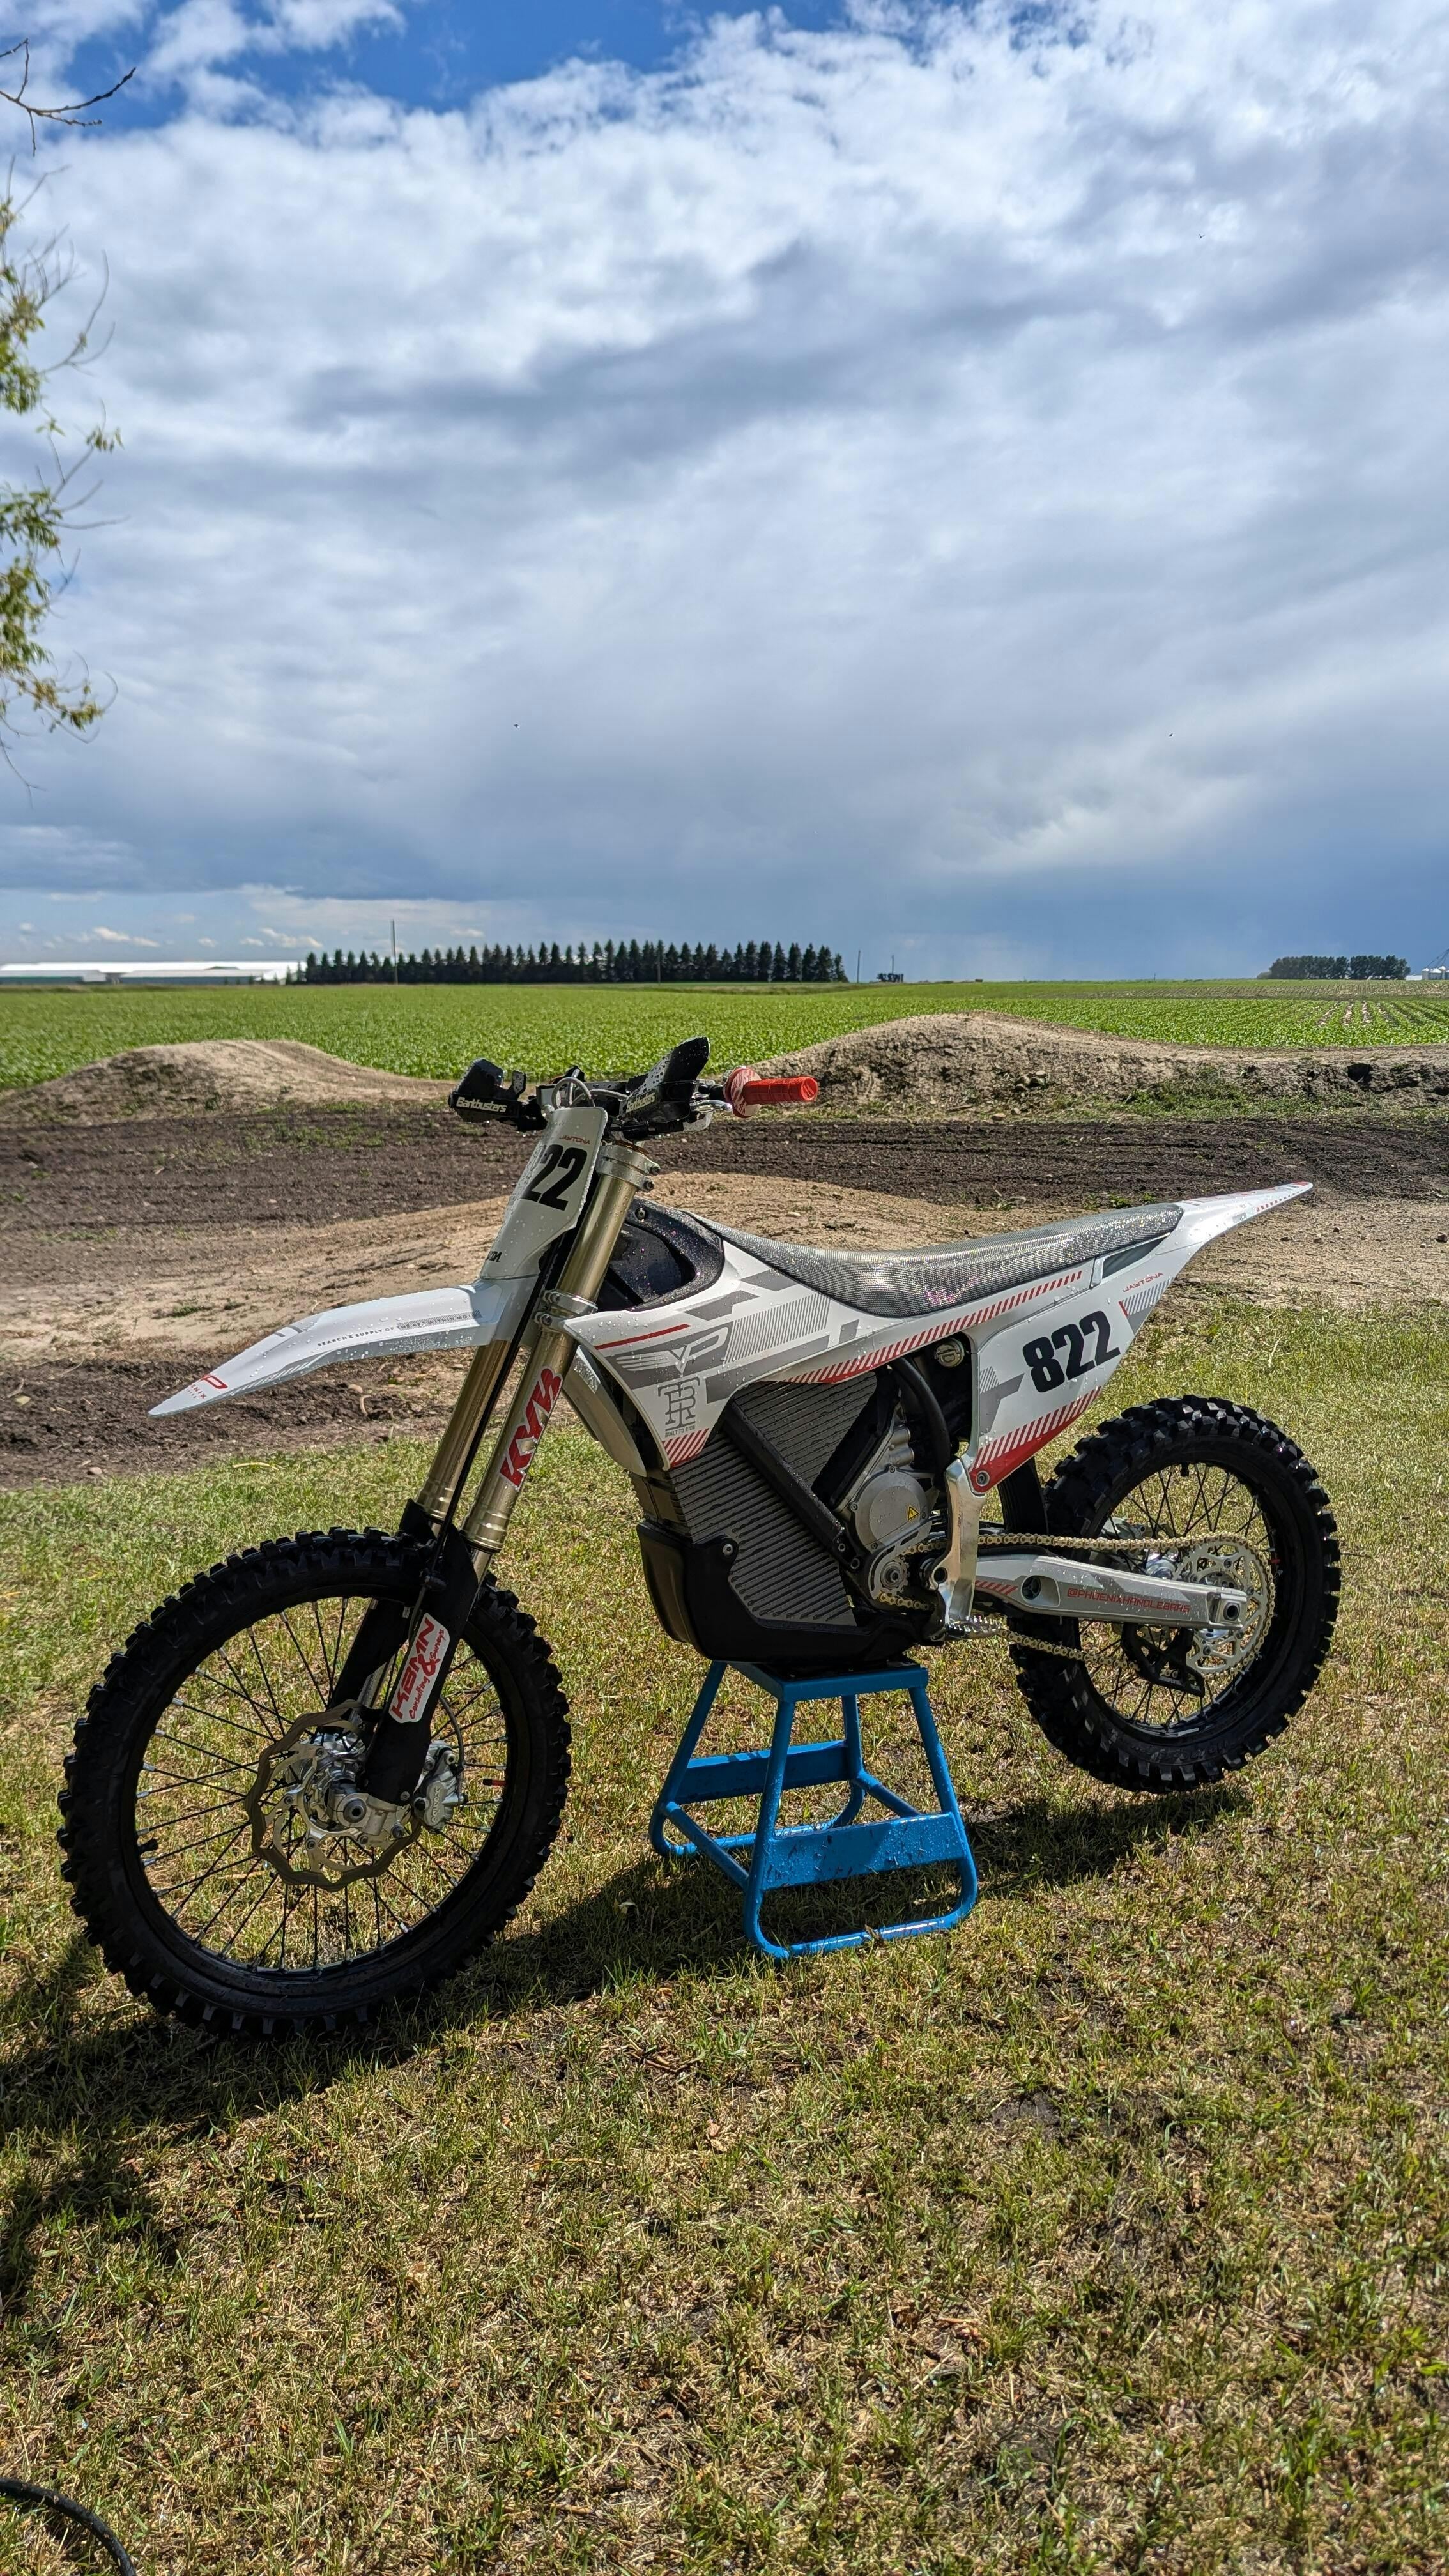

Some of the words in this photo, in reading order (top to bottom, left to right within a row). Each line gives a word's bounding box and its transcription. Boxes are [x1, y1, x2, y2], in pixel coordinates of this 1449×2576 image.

[456, 1096, 508, 1113] Barkbusters
[317, 1335, 348, 1347] SEARCH
[355, 1328, 383, 1337] SUPPLY
[1022, 1310, 1121, 1393] 822
[1067, 1587, 1191, 1613] @PHOENIXHANDLEBARS
[429, 1628, 447, 1660] Surveys
[417, 1653, 441, 1676] &
[408, 1675, 431, 1719] Consulting
